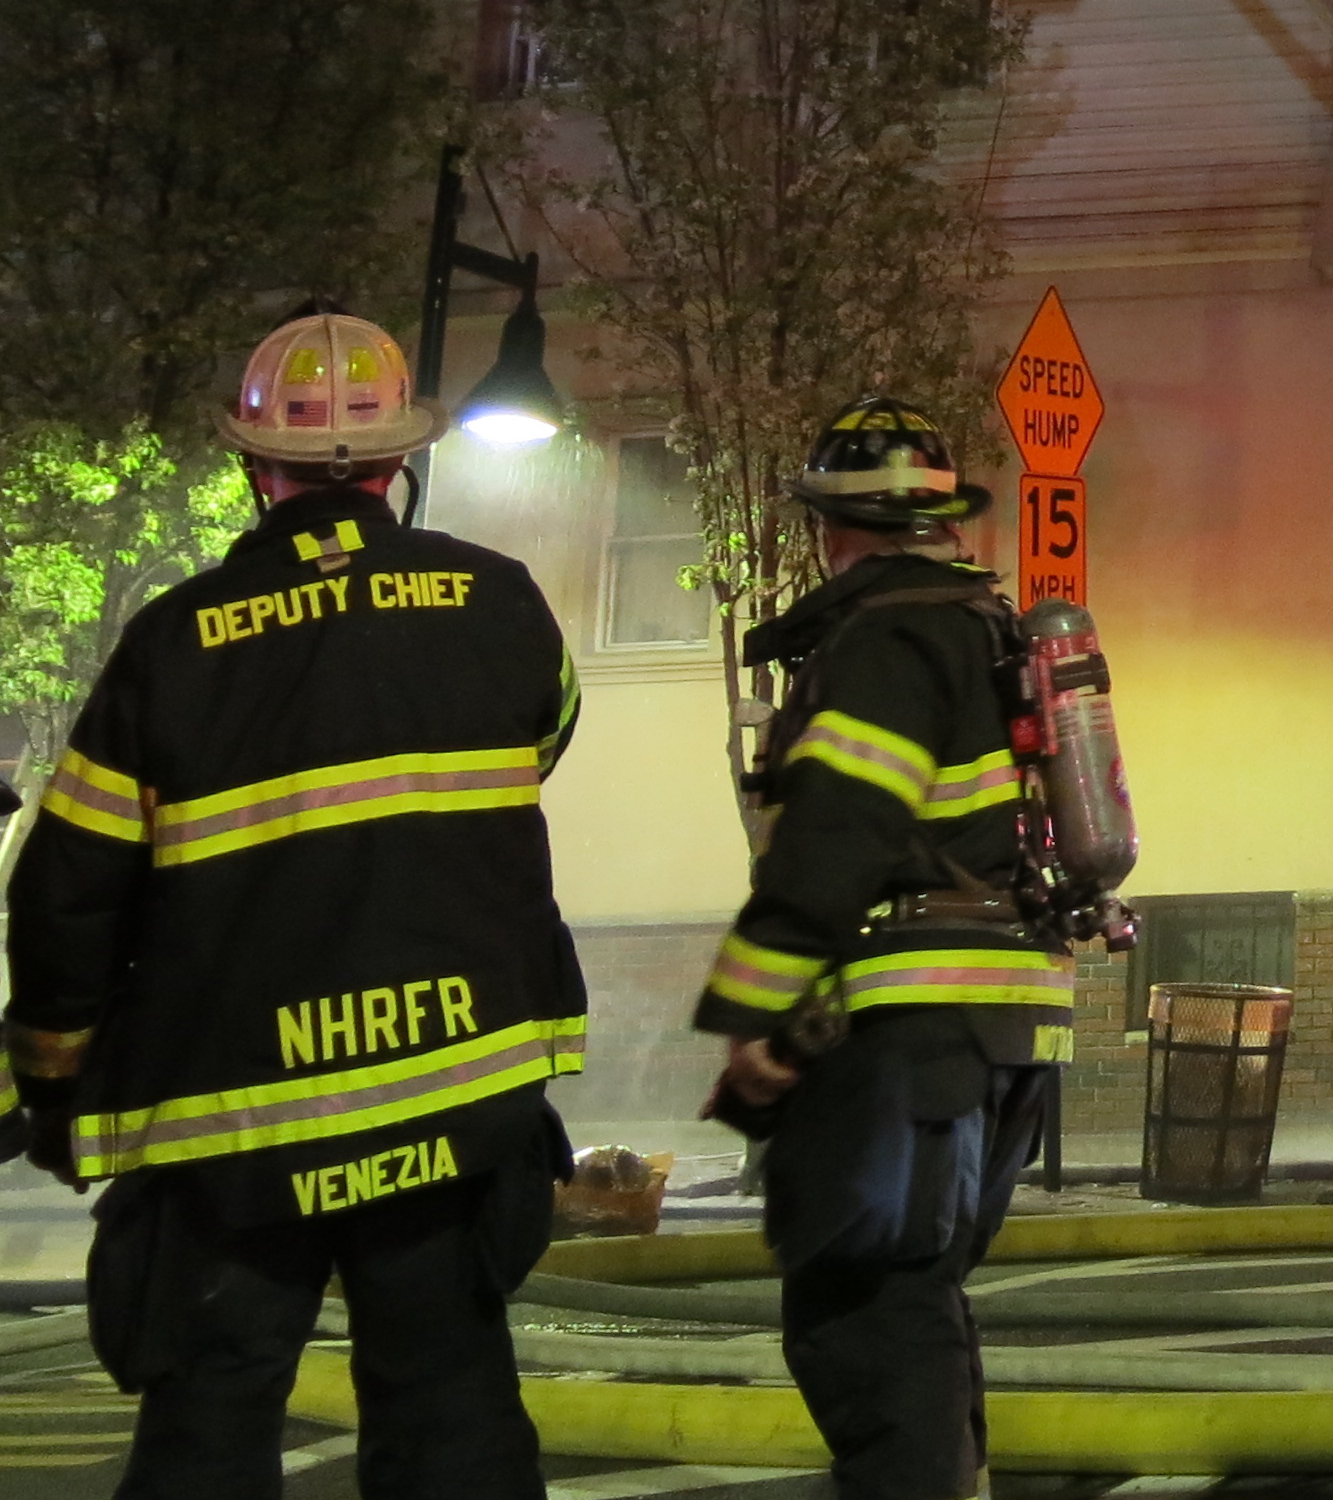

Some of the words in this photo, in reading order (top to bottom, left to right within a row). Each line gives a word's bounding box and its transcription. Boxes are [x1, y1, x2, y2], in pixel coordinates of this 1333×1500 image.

[1019, 354, 1084, 399] SPEED
[1023, 409, 1079, 449] HUMP
[1026, 484, 1079, 559] 15
[196, 575, 350, 648] DEPUTY
[369, 571, 474, 608] CHIEF
[1030, 574, 1076, 603] MPH
[277, 976, 477, 1069] NHRFR
[292, 1136, 458, 1215] VENEZIA
